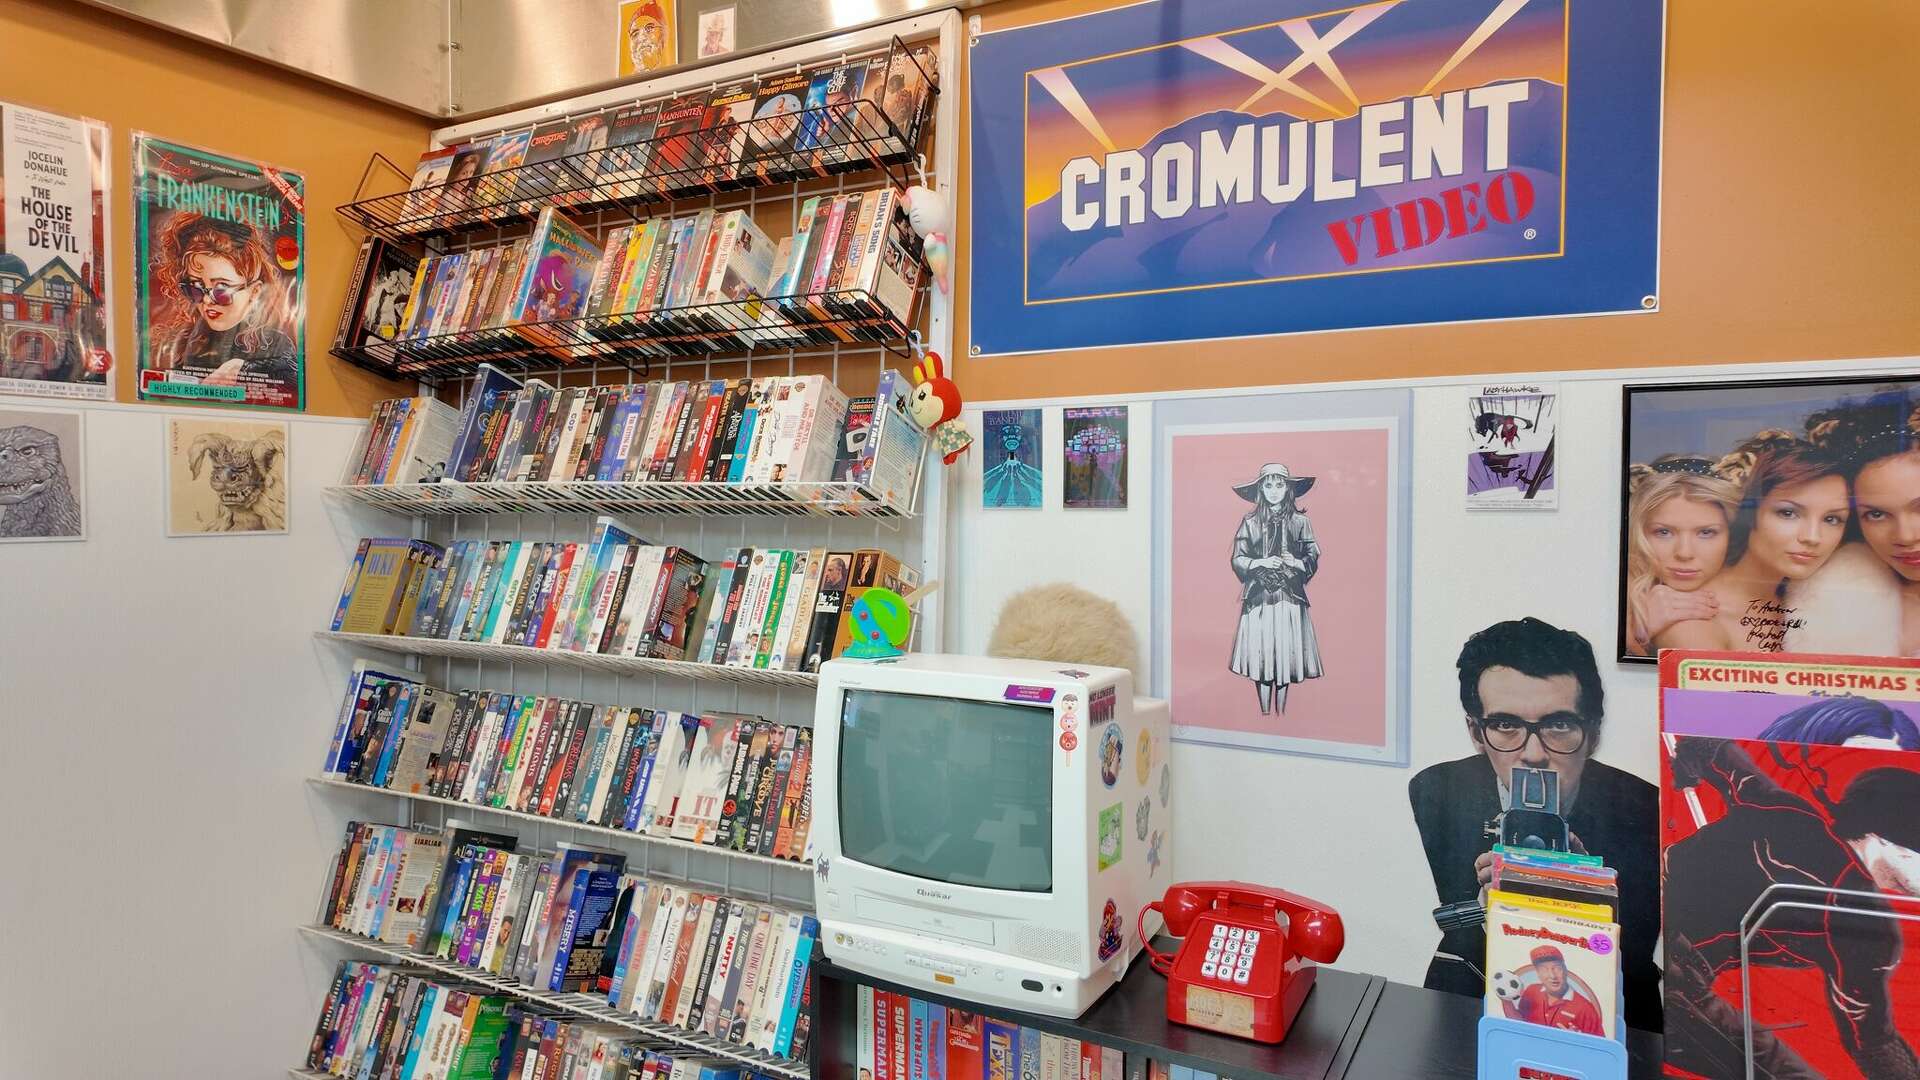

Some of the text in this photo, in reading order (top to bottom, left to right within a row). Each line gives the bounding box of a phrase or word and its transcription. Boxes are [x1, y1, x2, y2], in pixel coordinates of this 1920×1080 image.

[759, 80, 810, 97] Happy Gilmore
[784, 75, 804, 84] Sandler
[659, 106, 704, 123] MANHUNTER
[24, 160, 68, 177] DONAHUE
[28, 150, 64, 165] JOCELIN
[211, 164, 237, 176] SOMEONE
[1061, 81, 1529, 232] CROMULENT
[21, 198, 72, 223] HOUSE
[31, 185, 51, 200] THE
[158, 173, 280, 232] FRANKENSTEIN
[35, 218, 72, 235] OF THE
[868, 190, 890, 254] BRIAN'S SONG
[1326, 170, 1536, 266] VIDEO
[28, 227, 80, 254] DEVIL
[648, 242, 664, 291] BEDAZZLED
[154, 384, 182, 396] HIGHLY
[184, 386, 238, 398] RECOMMENDED
[868, 394, 886, 448] DOUBLE TAKE
[505, 578, 520, 606] envy
[513, 562, 535, 616] EXCALIBUR
[596, 569, 617, 620] FEVER PITCH
[647, 567, 669, 623] FREQUENCY
[1746, 599, 1798, 614] To Andrew
[792, 585, 811, 640] GLADIATOR
[1689, 667, 1907, 692] EXCITING CHRISTMAS
[1089, 700, 1116, 728] MINT
[526, 720, 549, 777] HOPE FLOATS
[536, 729, 558, 785] HUNTED
[563, 740, 581, 780] DREAMS
[616, 726, 634, 770] INSOMNIA
[622, 747, 641, 794] INVITATION
[728, 742, 747, 796] JURASSIC PARK
[693, 795, 720, 817] IT
[752, 766, 772, 818] GROOVE
[471, 883, 486, 911] MASK
[540, 875, 559, 924] MIRACLE
[916, 888, 952, 901] Quasar
[558, 908, 576, 953] MISERY
[740, 929, 749, 944] THE
[1556, 916, 1612, 932] LADYBUGS
[1591, 938, 1610, 951] $5
[662, 931, 676, 962] GIANT
[668, 941, 688, 985] Natural
[718, 935, 735, 978] NUTTY
[744, 932, 765, 990] ONE FINE DAY
[876, 1000, 887, 1078] SUPERMAN
[914, 1018, 923, 1080] SUPERMAN
